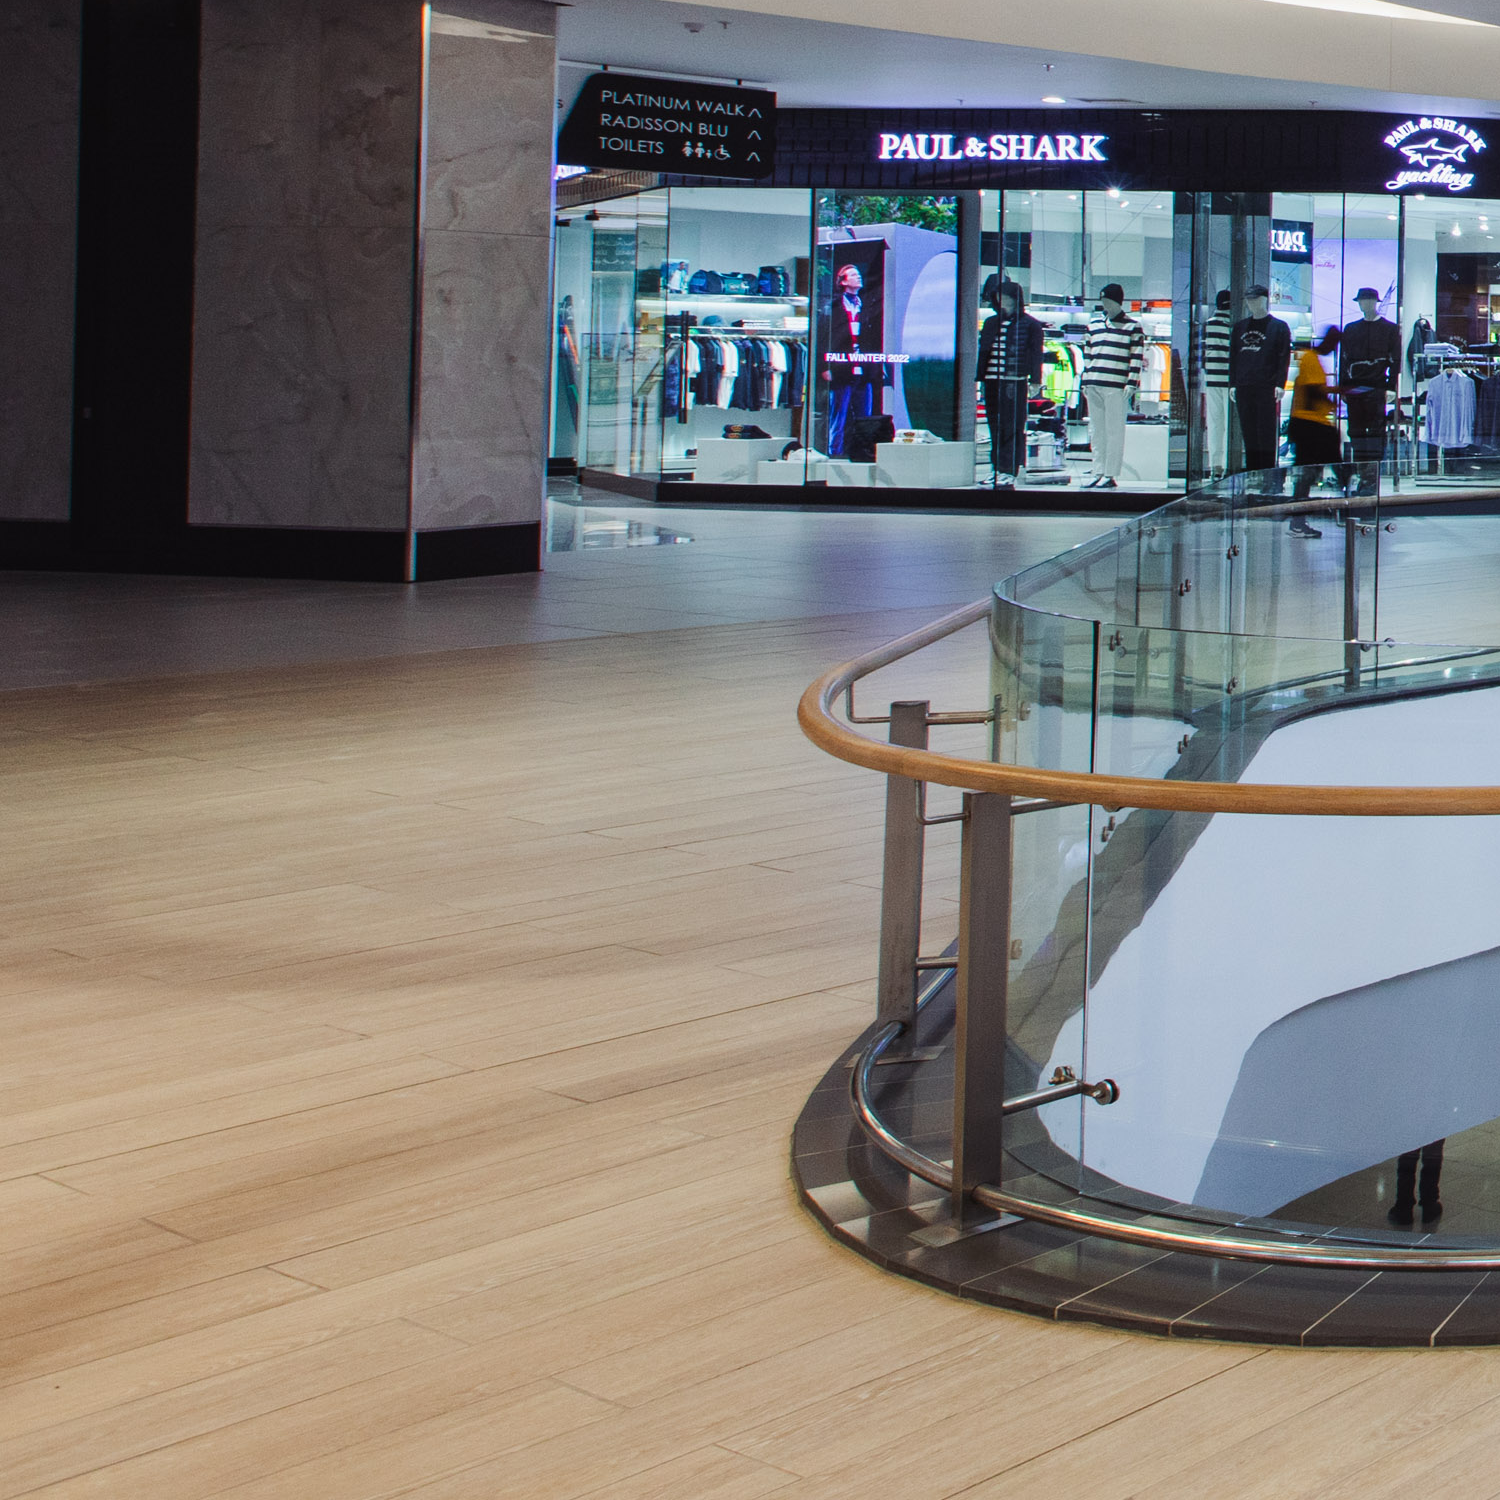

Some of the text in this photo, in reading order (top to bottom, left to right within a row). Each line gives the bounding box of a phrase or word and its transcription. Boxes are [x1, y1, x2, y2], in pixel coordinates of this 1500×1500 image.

[601, 90, 744, 117] PLATINUM WALK
[600, 113, 728, 137] RADISSON BLU
[1384, 117, 1487, 153] PAUL & SHARK
[599, 136, 664, 154] TOILETS
[878, 133, 1109, 160] PAUL & SHARK
[1385, 163, 1474, 190] yachting
[824, 352, 910, 363] FALL WINTER 2022
